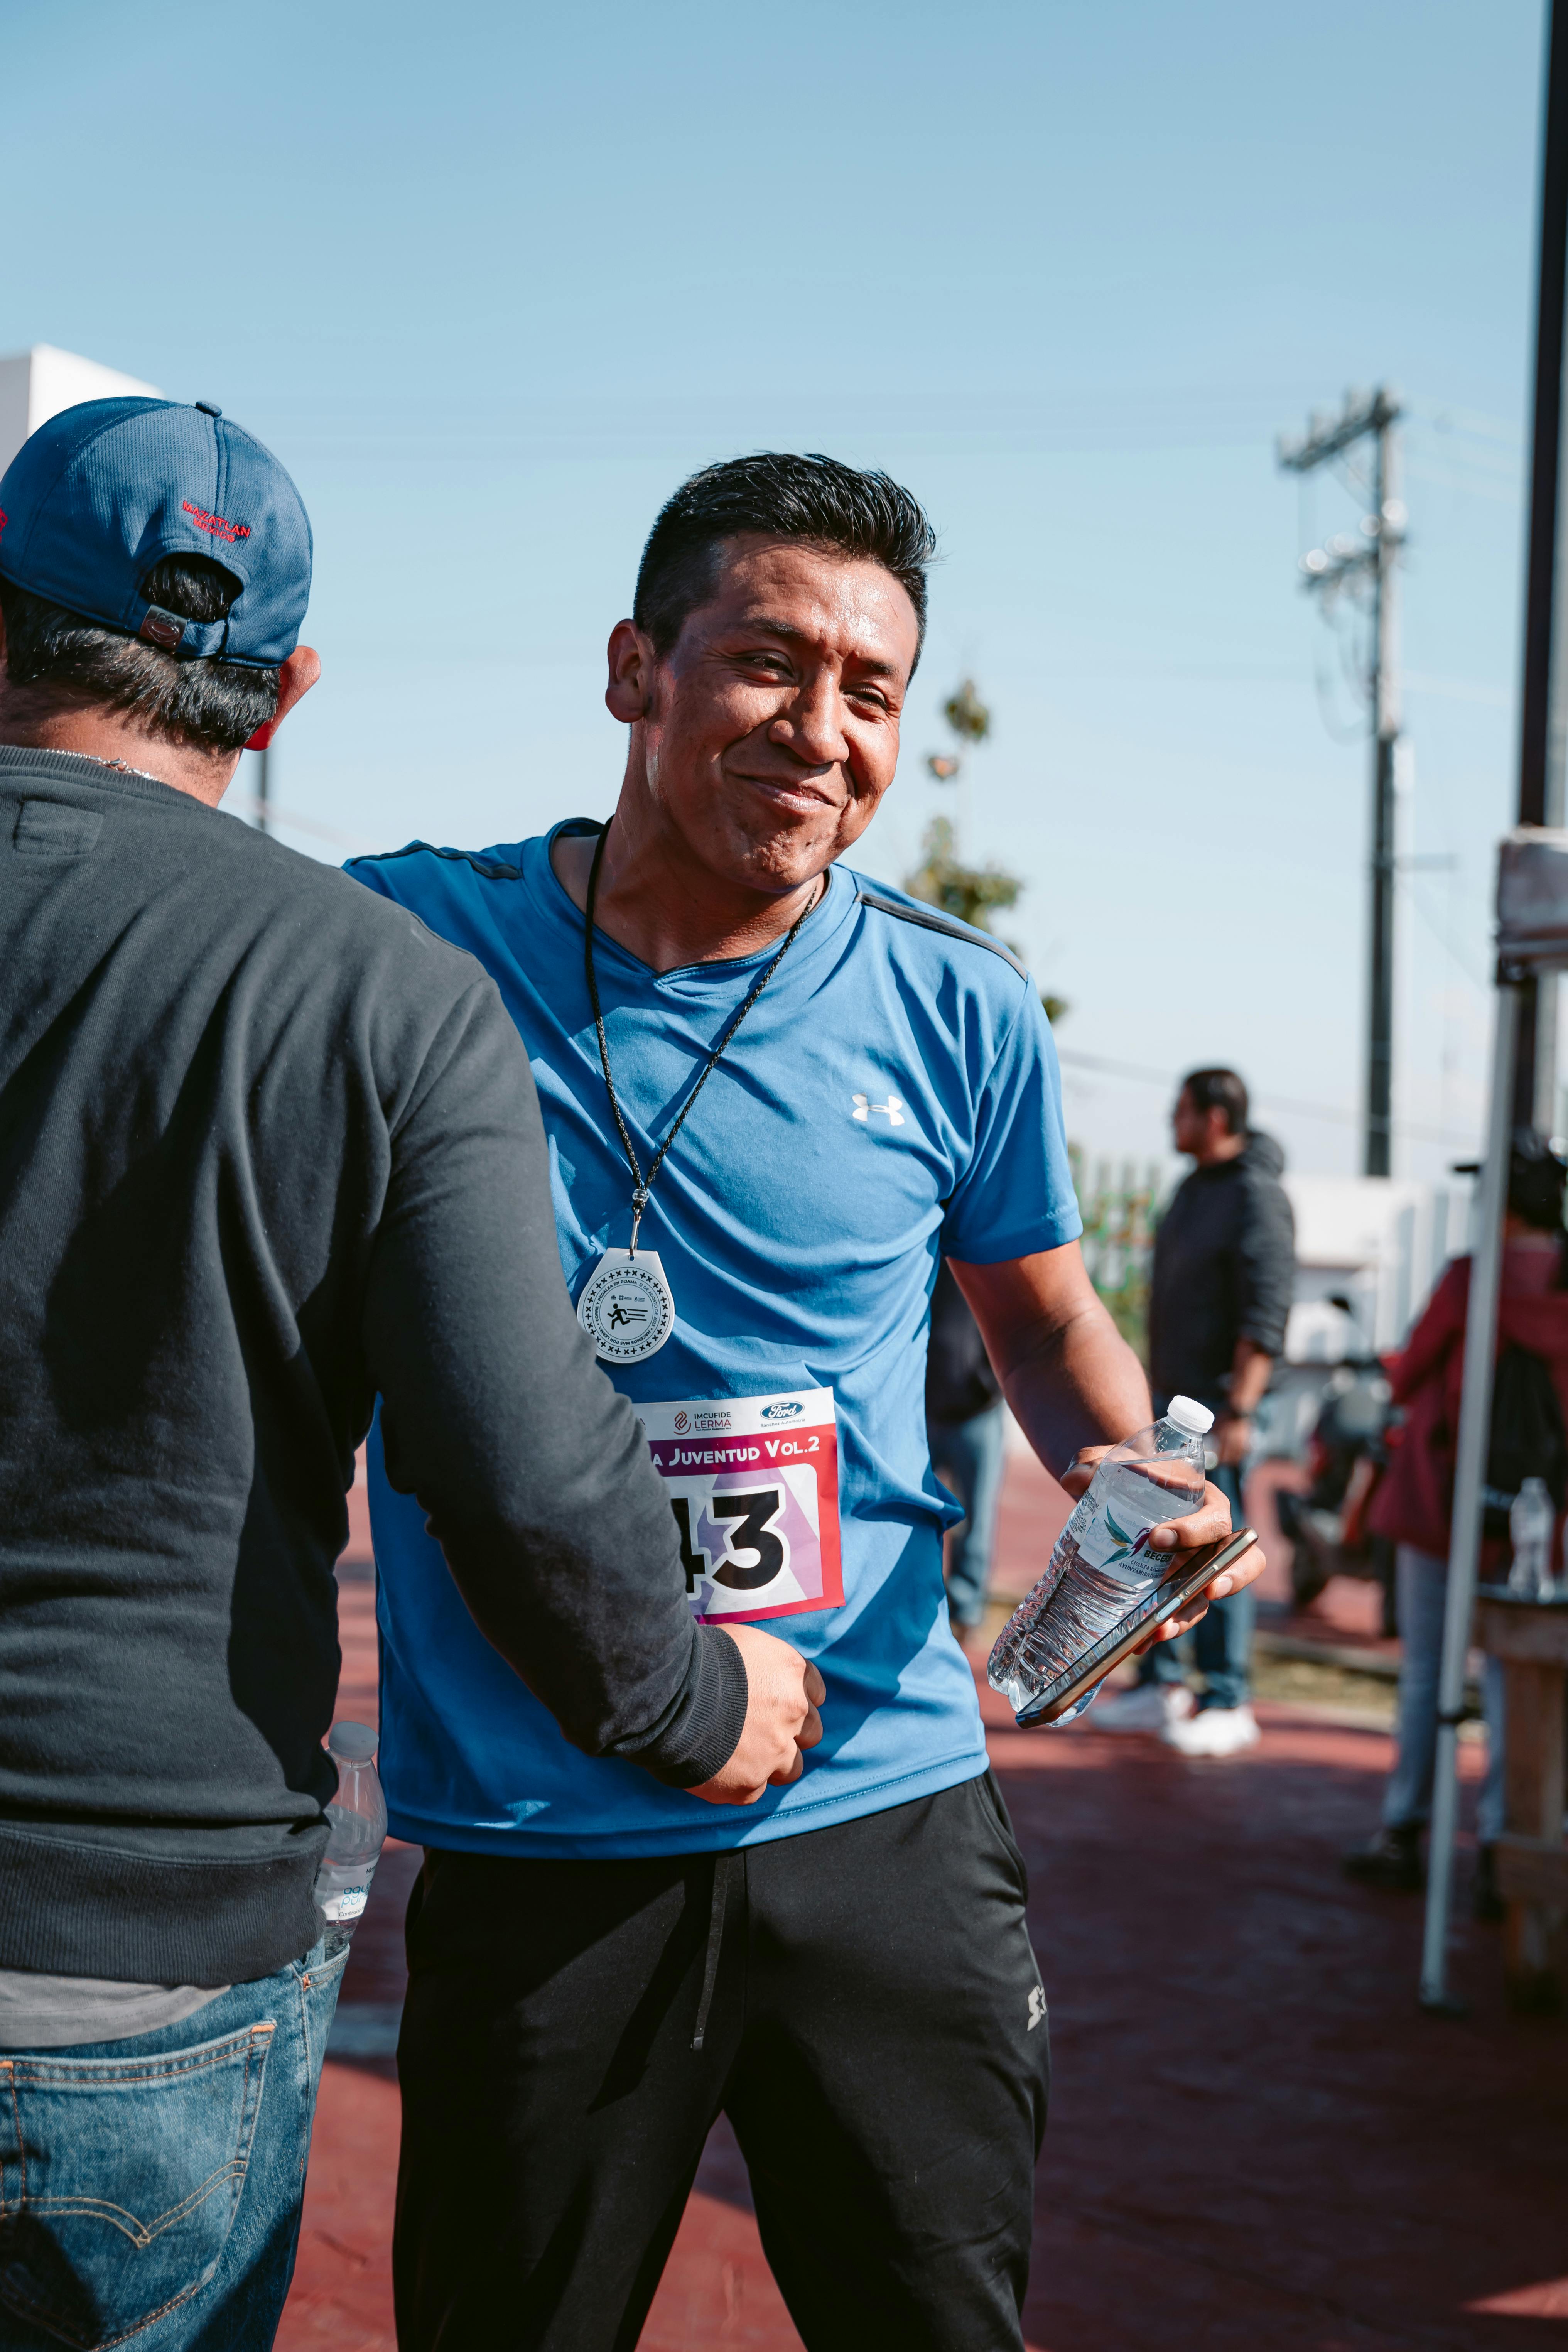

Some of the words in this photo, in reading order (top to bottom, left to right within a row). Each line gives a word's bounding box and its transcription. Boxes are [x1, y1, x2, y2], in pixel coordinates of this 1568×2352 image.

[182, 500, 251, 538] MAZATLAN
[193, 518, 235, 543] MEXICO
[597, 1284, 613, 1301] PEDALEA
[648, 1291, 658, 1308] AGOSTO
[599, 1326, 610, 1340] LERMA
[631, 1330, 651, 1345] HACEMOS
[768, 1403, 797, 1418] Ford
[695, 1419, 731, 1429] LERMA
[669, 1447, 760, 1466] JUVENTUD
[1118, 1562, 1154, 1578] AYUNTAMIENTO
[1131, 1560, 1149, 1570] CUARTA
